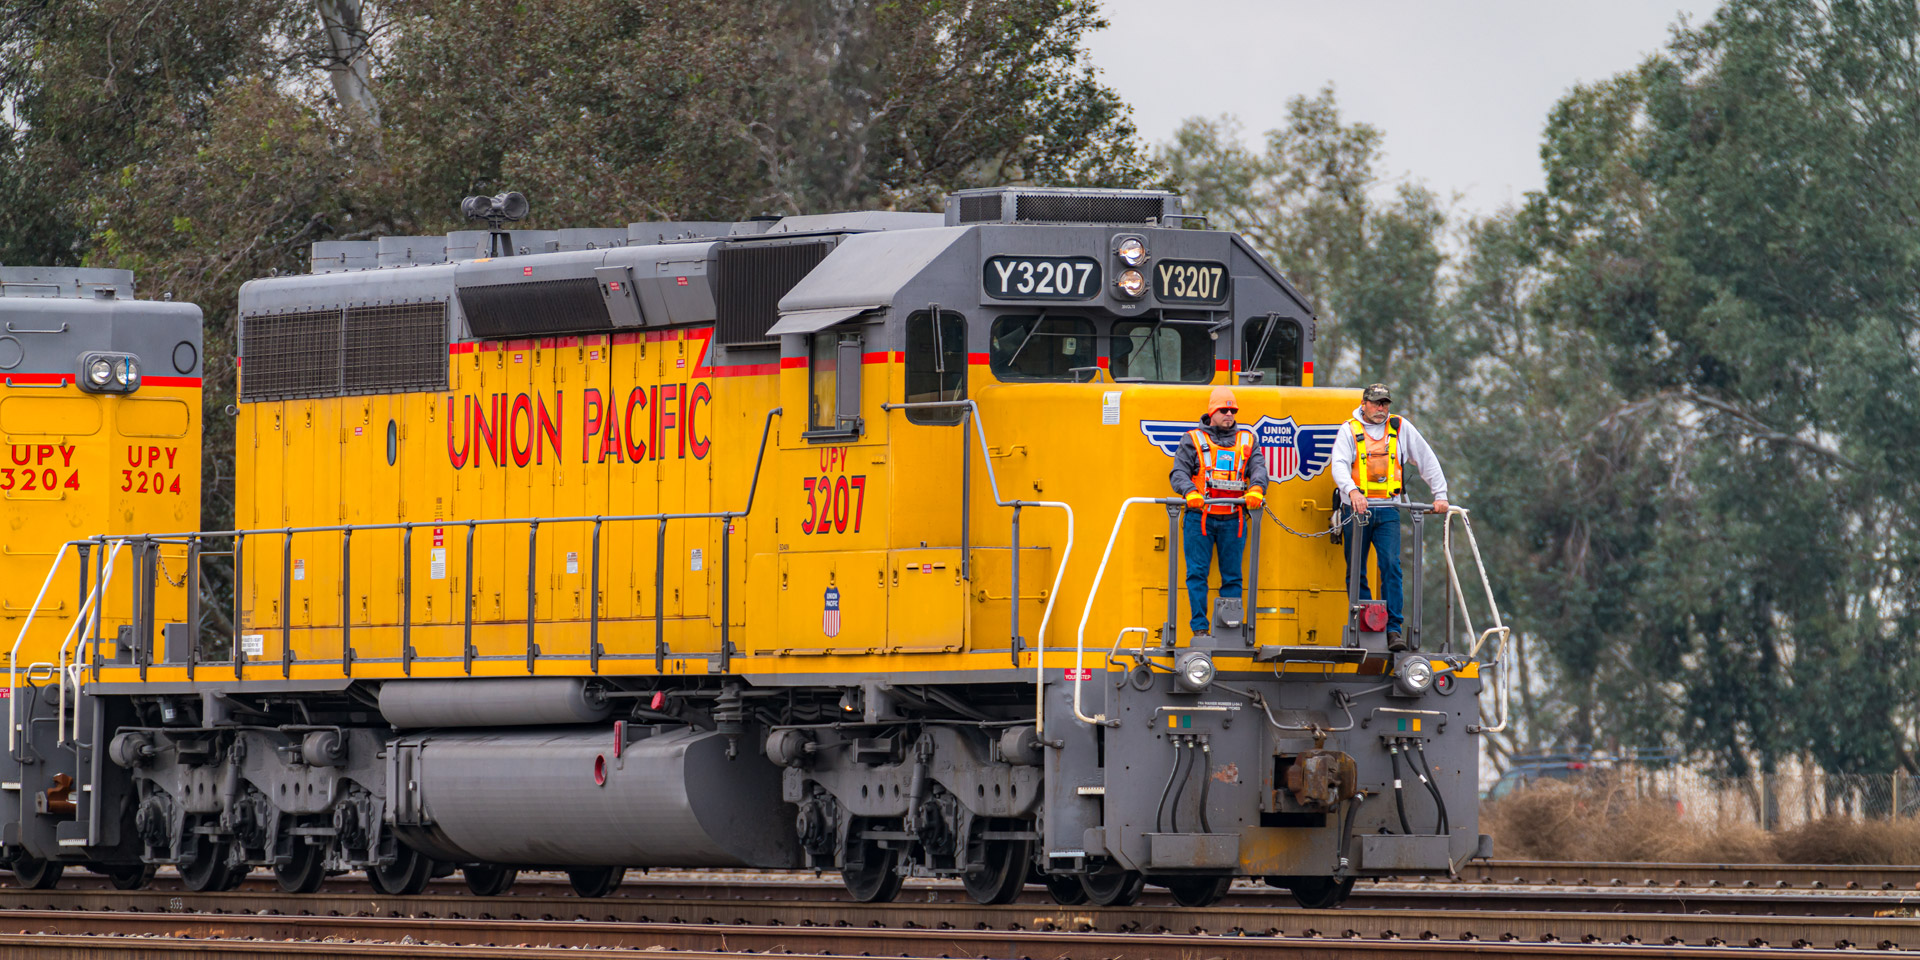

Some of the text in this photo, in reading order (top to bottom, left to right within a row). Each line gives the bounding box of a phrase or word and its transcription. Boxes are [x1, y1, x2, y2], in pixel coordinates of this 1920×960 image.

[994, 261, 1093, 294] Y3207
[1159, 265, 1222, 298] Y3207
[447, 381, 713, 470] UNION PACIFIC
[1263, 426, 1292, 435] UNION
[1261, 435, 1293, 445] PACIFIC
[12, 445, 76, 467] UPY
[129, 446, 177, 468] UPY
[820, 448, 848, 473] UPY
[0, 469, 80, 491] 3204
[122, 470, 181, 495] 3204
[801, 474, 867, 536] 3207
